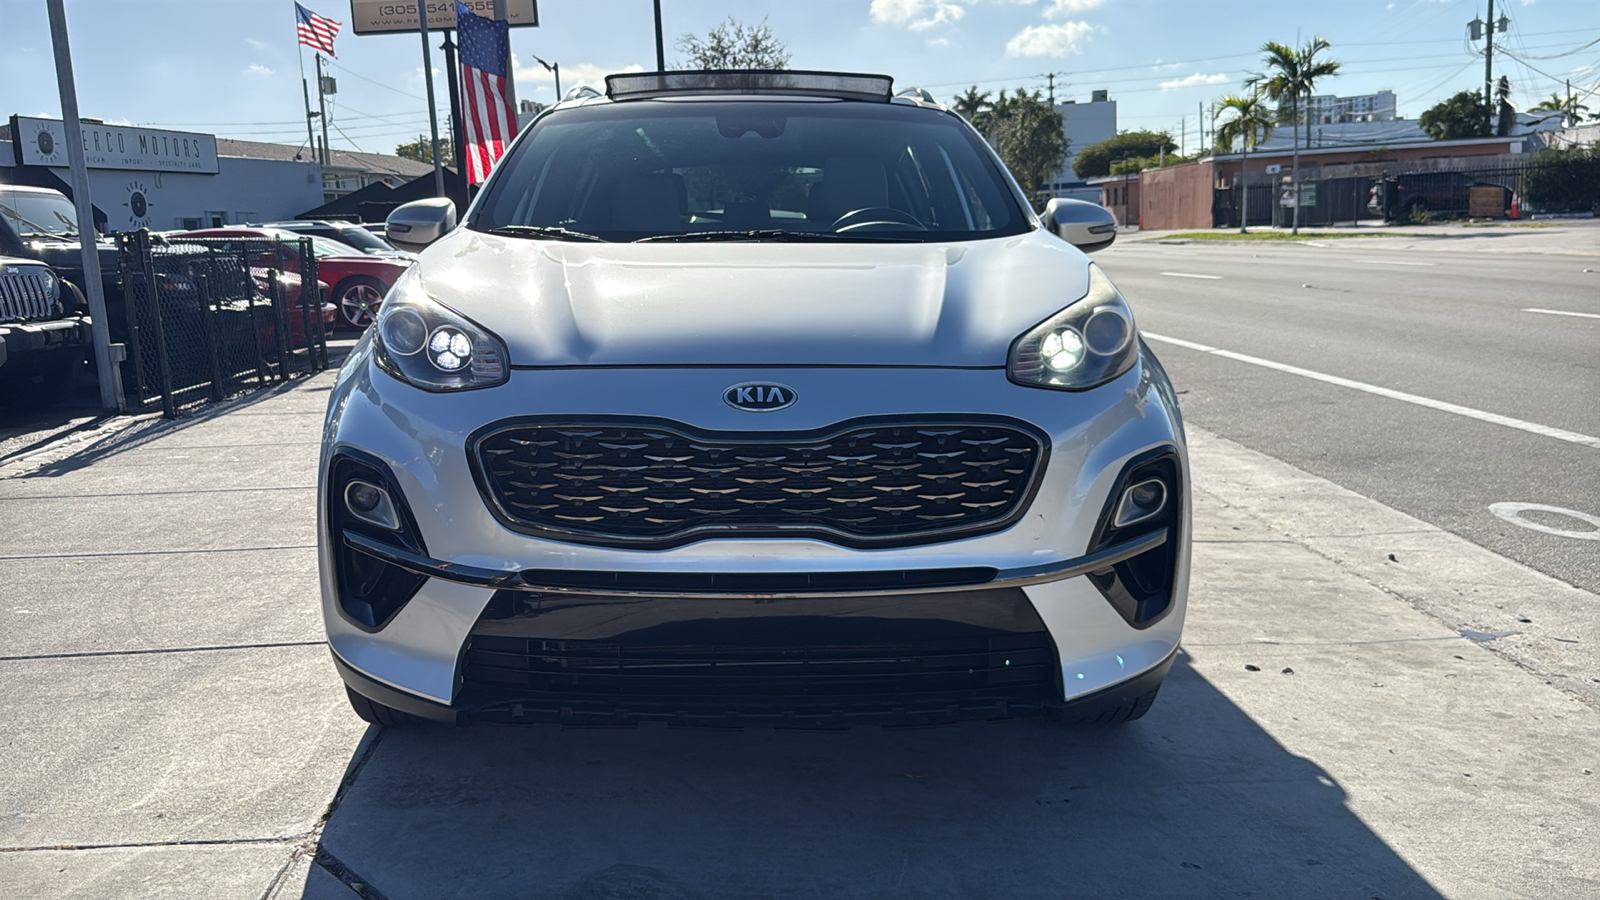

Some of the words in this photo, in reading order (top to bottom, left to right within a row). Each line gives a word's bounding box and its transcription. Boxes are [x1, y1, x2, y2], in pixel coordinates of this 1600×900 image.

[379, 4, 417, 17] (305
[82, 129, 125, 153] ERCO
[139, 134, 200, 159] MOTORS
[86, 156, 106, 164] RICAN
[121, 158, 144, 166] IMPORT
[736, 386, 786, 404] KIA
